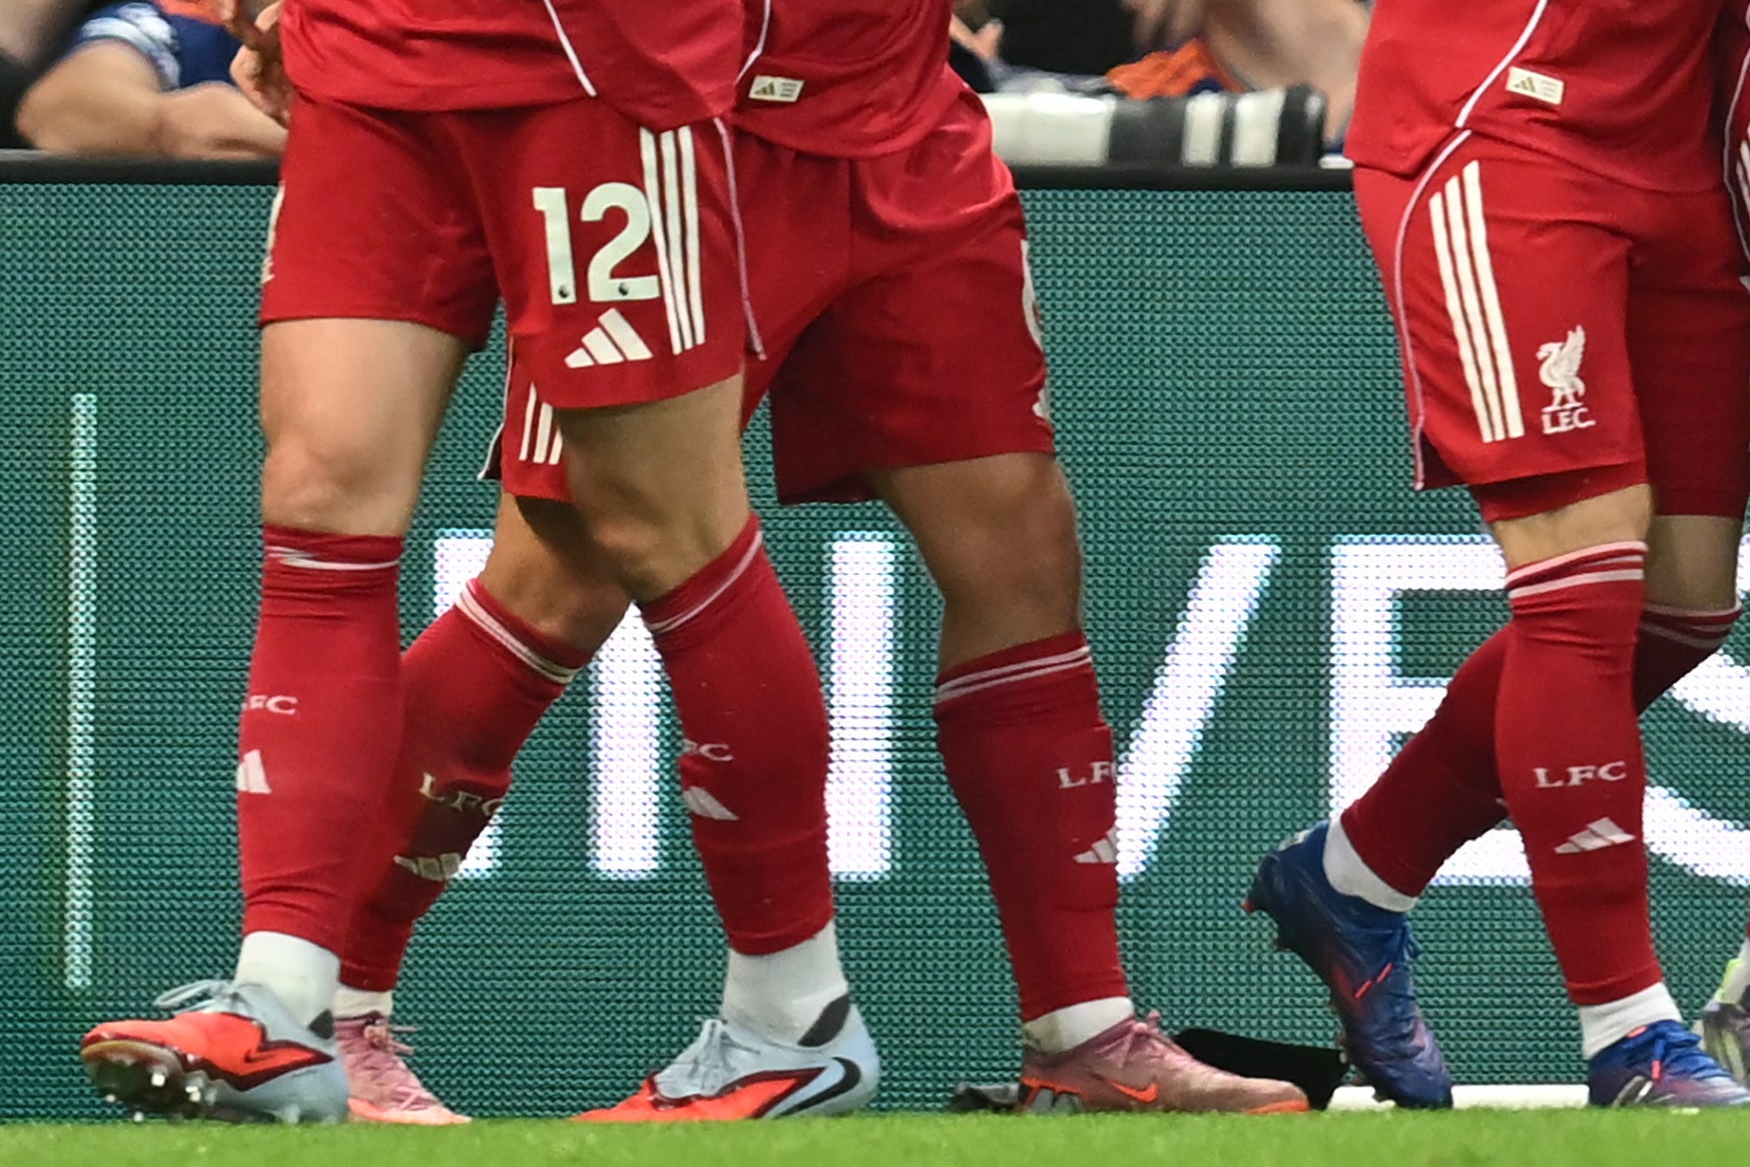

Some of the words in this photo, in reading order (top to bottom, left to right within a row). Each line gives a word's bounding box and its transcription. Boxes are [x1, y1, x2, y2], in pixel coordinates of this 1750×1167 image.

[532, 181, 661, 307] 12
[1055, 760, 1118, 789] LF
[1533, 760, 1628, 789] LFC
